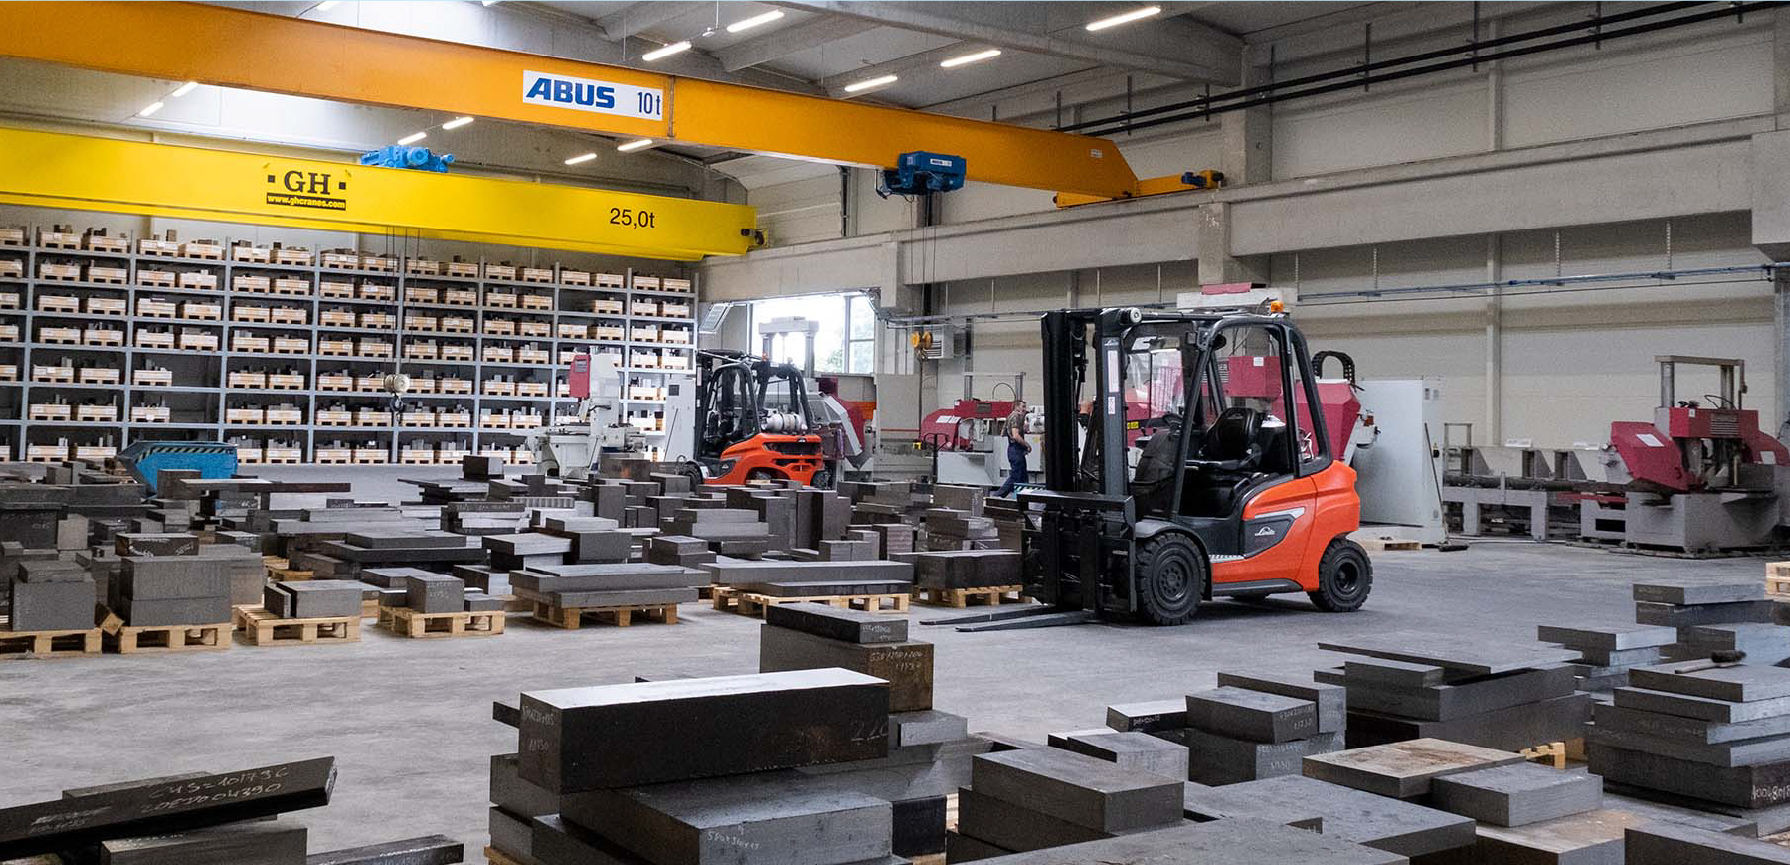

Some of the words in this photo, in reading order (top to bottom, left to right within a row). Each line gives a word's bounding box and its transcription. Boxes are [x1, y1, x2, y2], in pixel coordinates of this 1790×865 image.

[526, 77, 615, 109] ABUS
[284, 170, 331, 195] GH
[610, 207, 655, 229] 25,0t
